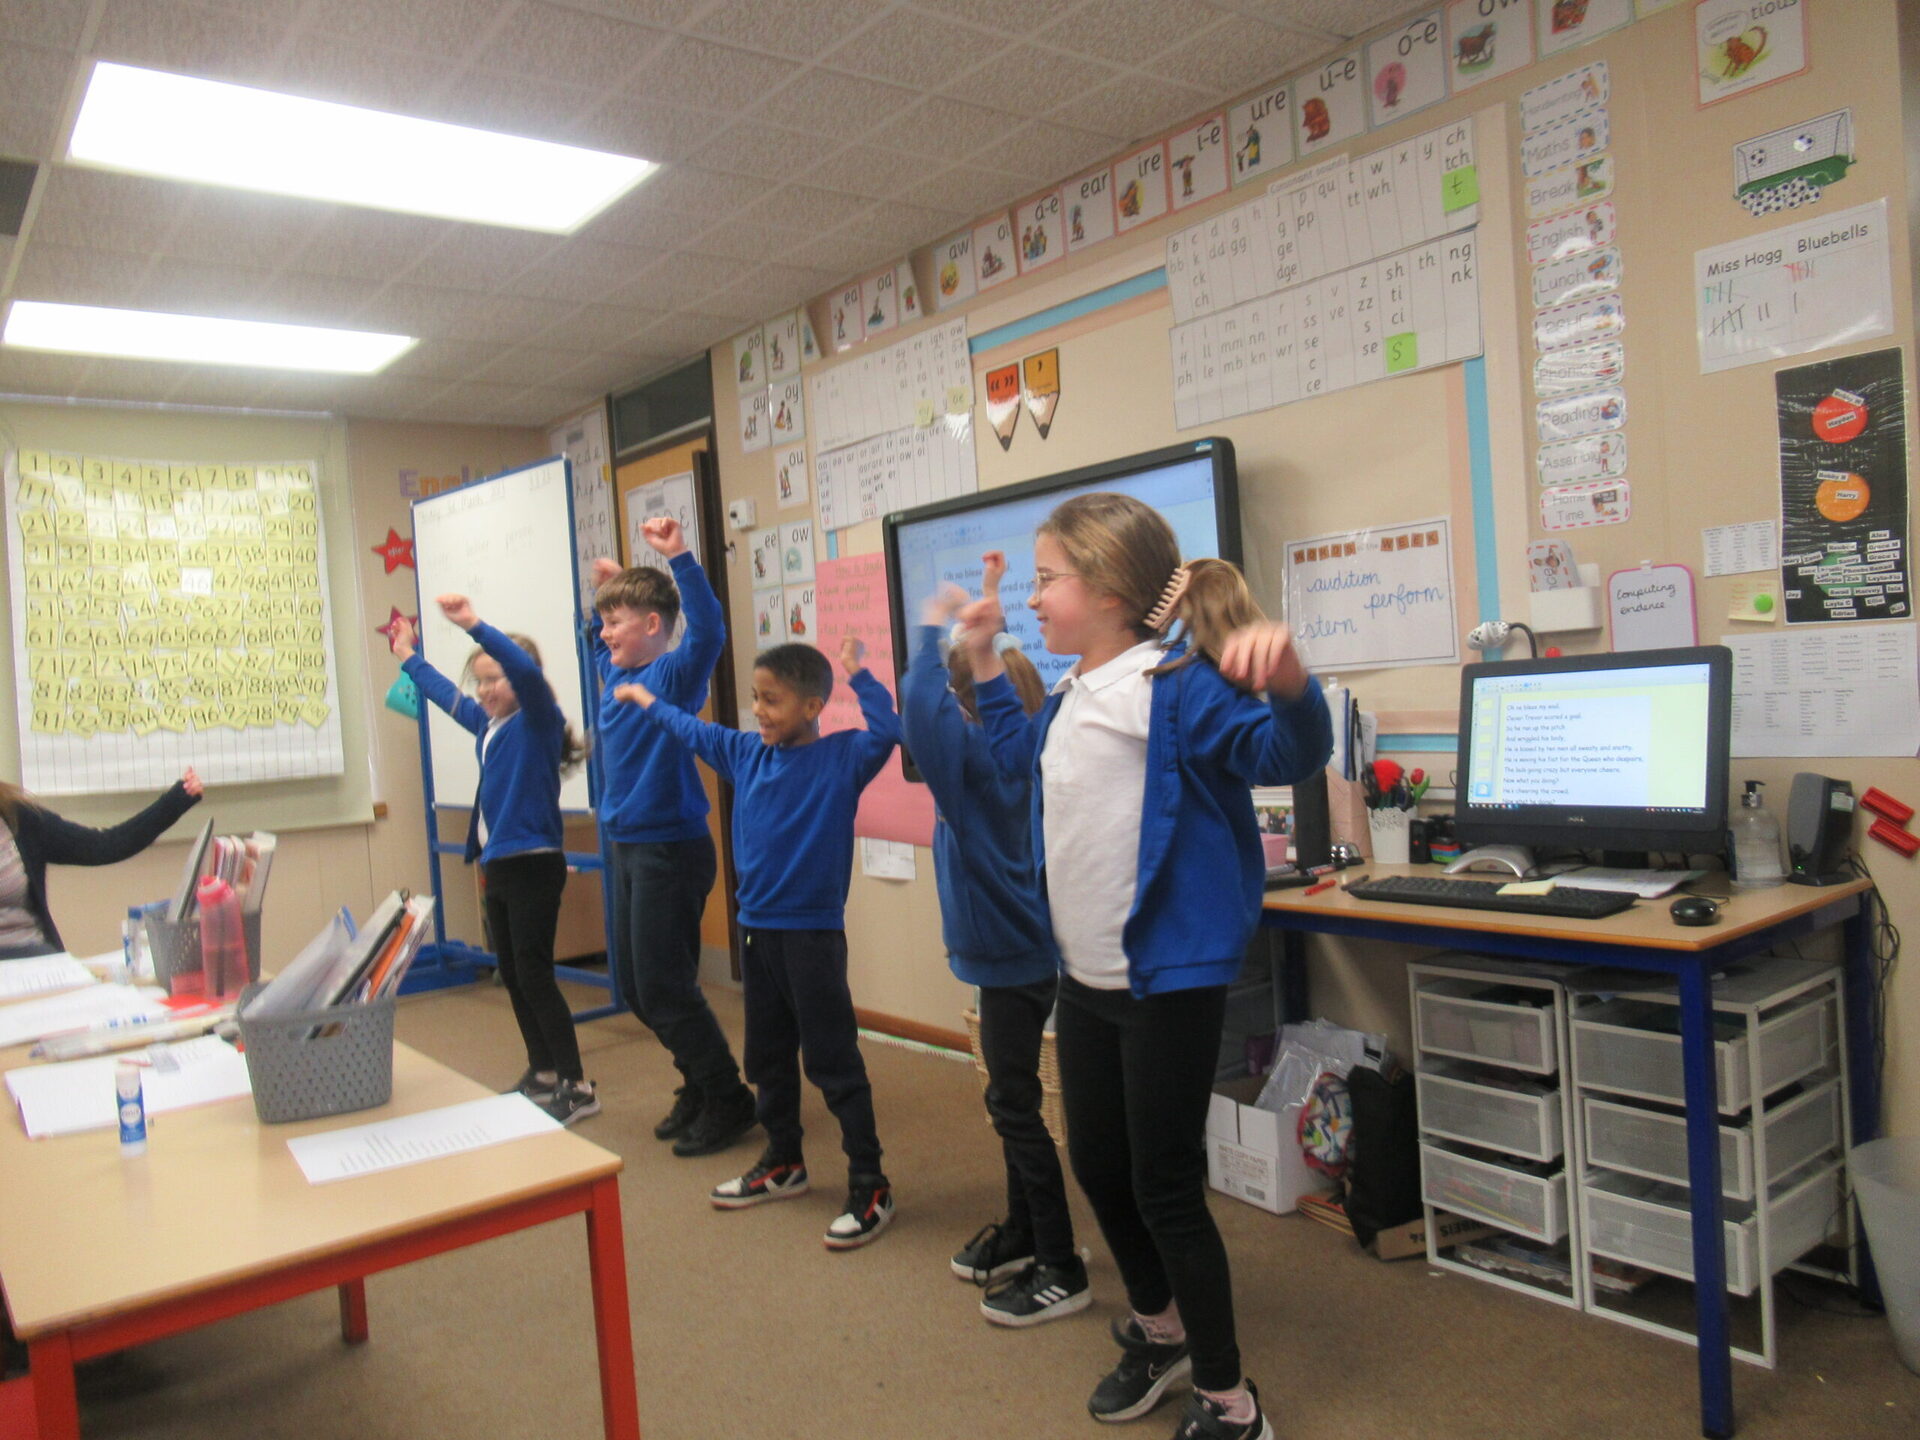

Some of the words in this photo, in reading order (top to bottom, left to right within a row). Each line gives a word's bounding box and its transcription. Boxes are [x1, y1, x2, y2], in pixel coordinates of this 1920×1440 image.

[1251, 89, 1286, 121] ure
[1446, 127, 1465, 146] ch
[1445, 149, 1470, 169] tch
[1527, 138, 1569, 162] Maths
[1138, 151, 1161, 178] ire
[1080, 171, 1108, 199] ear
[1318, 180, 1335, 198] qu
[1367, 180, 1391, 199] wh
[1530, 179, 1575, 205] Break
[1297, 211, 1314, 232] pp
[1531, 225, 1583, 250] English
[949, 239, 970, 260] aw
[1277, 241, 1293, 260] ge
[1450, 243, 1471, 263] ng
[1707, 259, 1741, 278] Miss
[1745, 248, 1783, 268] Hogg
[1797, 223, 1869, 254] Bluebells
[1419, 252, 1436, 270] th
[1276, 263, 1297, 282] dge
[1387, 262, 1404, 281] sh
[1451, 264, 1473, 284] nk
[1539, 269, 1585, 293] Lunch
[877, 273, 892, 292] oa
[844, 289, 858, 306] ea
[748, 332, 761, 351] oo
[785, 383, 800, 402] oy
[753, 393, 768, 413] ay
[789, 450, 804, 467] ou
[33, 453, 38, 472] 1
[59, 459, 71, 476] 2
[93, 462, 104, 480] 3
[121, 467, 132, 484] 4
[149, 469, 160, 486] 5
[179, 470, 191, 486] 6
[207, 468, 217, 485] 7
[235, 469, 247, 486] 8
[291, 493, 314, 511] 20
[59, 513, 85, 531] 22
[267, 520, 290, 537] 29
[298, 520, 317, 537] 30
[1557, 510, 1585, 522] Time
[764, 533, 777, 549] ee
[791, 526, 810, 543] ow
[1381, 530, 1439, 552] WEEK
[295, 547, 317, 563] 40
[29, 571, 53, 590] 41
[93, 574, 120, 591] 43
[216, 572, 240, 590] 47
[1307, 570, 1381, 593] audition
[802, 588, 815, 606] ar
[1363, 583, 1444, 619] perform
[1004, 601, 1024, 614] pitch
[29, 627, 53, 646] 61
[65, 628, 91, 646] 62
[95, 629, 121, 647] 63
[128, 629, 153, 647] 64
[160, 627, 185, 643] 65
[216, 627, 240, 643] 67
[247, 628, 270, 644] 68
[303, 625, 322, 643] 70
[1297, 615, 1357, 640] stern
[302, 652, 325, 669] 80
[1037, 660, 1050, 670] the
[1051, 658, 1077, 672] Quee
[69, 683, 97, 700] 82
[101, 685, 128, 702] 83
[35, 709, 60, 730] 91
[101, 708, 127, 728] 93
[1582, 755, 1601, 763] Queen
